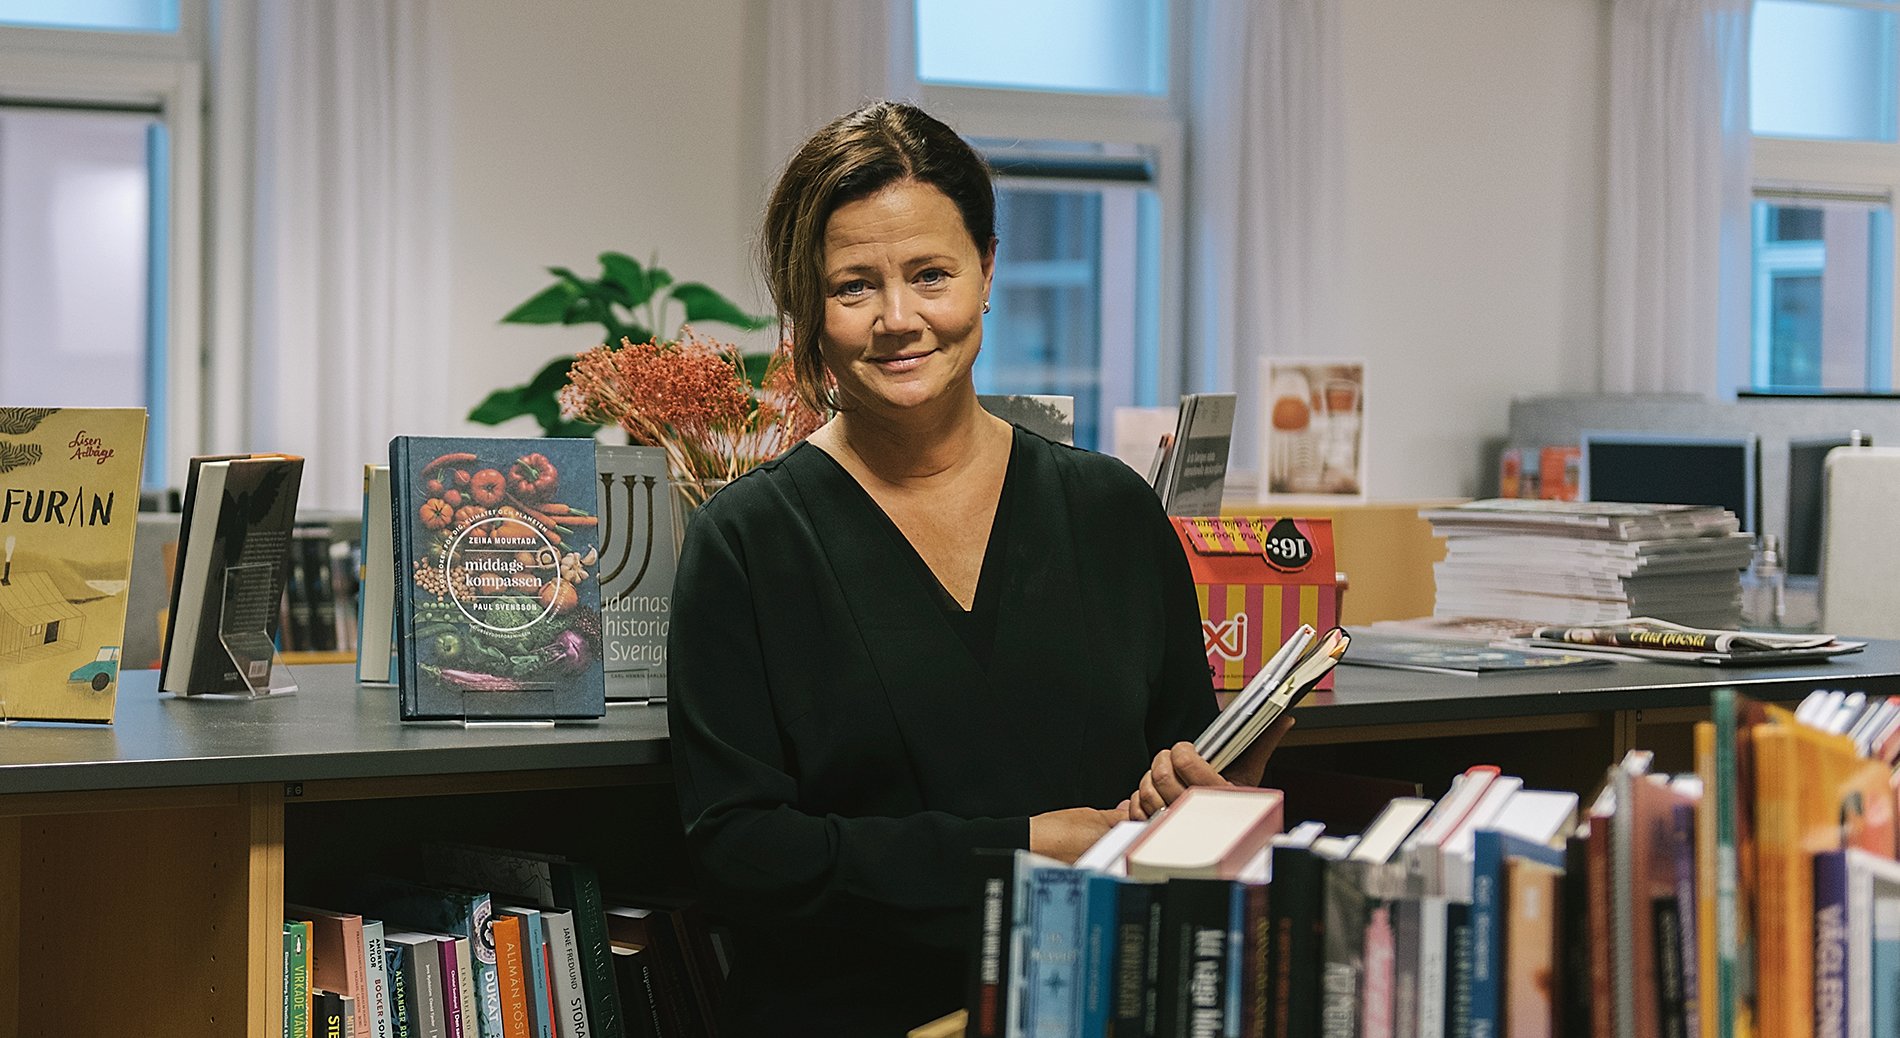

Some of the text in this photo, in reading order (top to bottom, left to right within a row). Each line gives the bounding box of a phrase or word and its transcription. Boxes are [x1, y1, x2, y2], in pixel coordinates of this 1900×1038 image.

[68, 430, 102, 448] Lisen
[468, 536, 537, 545] ZEINA MOURTADA
[515, 511, 548, 533] PLANETEN
[465, 558, 524, 574] middags
[465, 573, 542, 589] kompassen
[473, 603, 537, 611] PAUL SVENSSON
[506, 942, 520, 999] ALLMÄN
[563, 927, 578, 990] JANE FREDLUND
[294, 965, 304, 1010] VIRKADE
[375, 978, 384, 1017] BÖCKER
[395, 970, 406, 1023] ALEXANDER
[484, 970, 499, 1021] DUKAT
[463, 989, 472, 1031] KÅRELAND
[571, 997, 587, 1038] STORA
